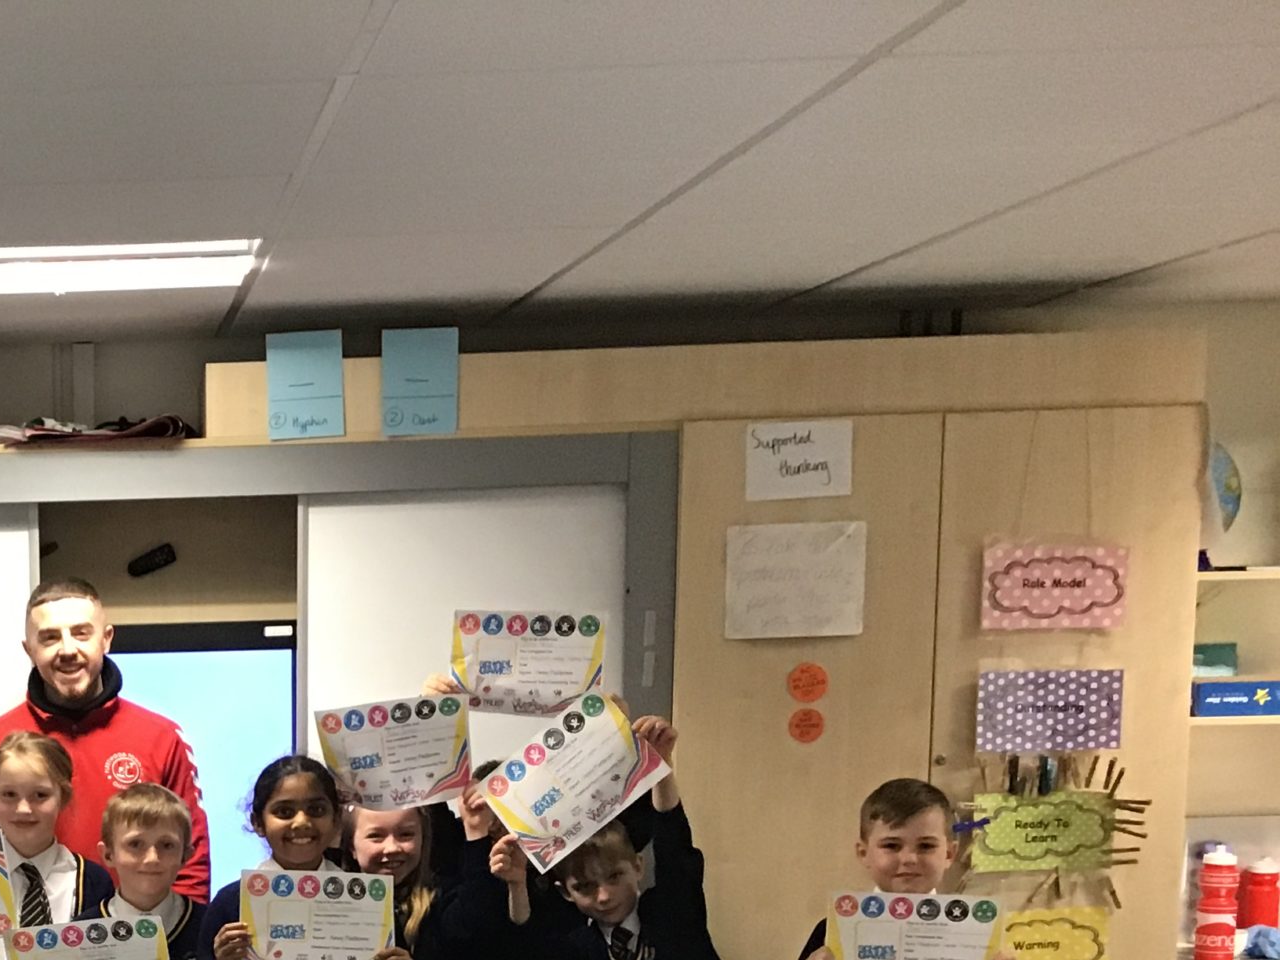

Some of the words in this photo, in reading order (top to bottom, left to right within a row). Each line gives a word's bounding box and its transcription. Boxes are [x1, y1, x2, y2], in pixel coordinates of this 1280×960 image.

[751, 428, 816, 456] Supported
[779, 458, 832, 486] thinking
[1022, 578, 1046, 589] Role
[1051, 577, 1087, 589] Model
[1014, 702, 1085, 715] Outstanding
[1015, 820, 1050, 831] Ready
[1054, 819, 1070, 829] To
[1024, 833, 1058, 844] Learn
[1012, 940, 1061, 951] Warning
